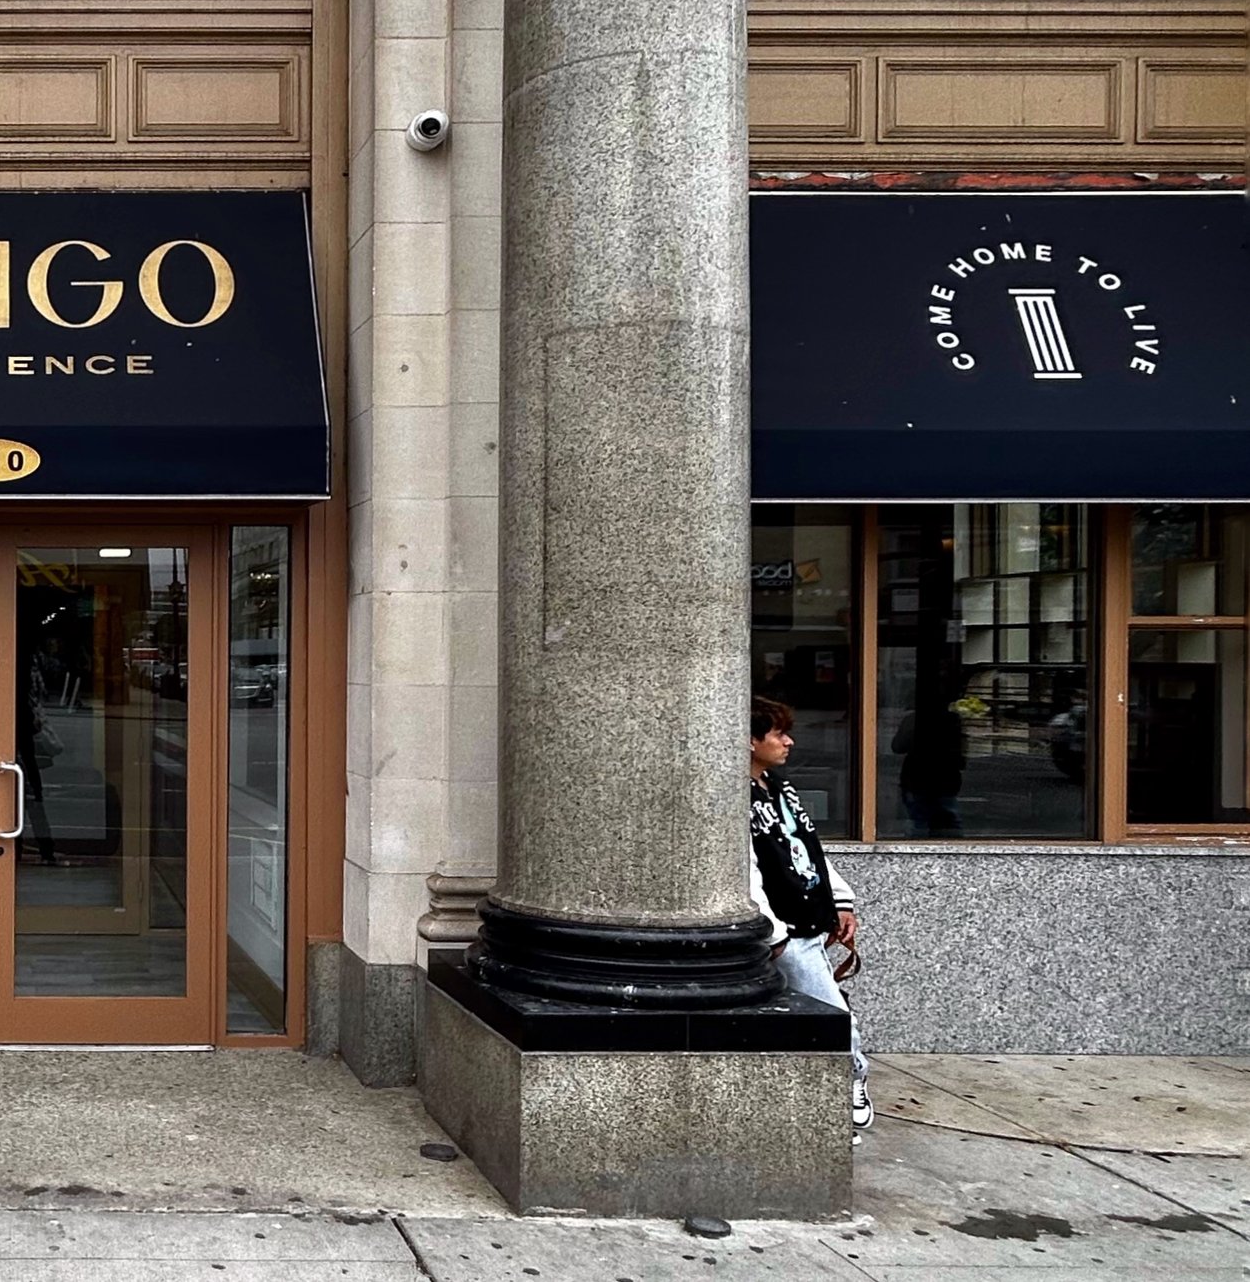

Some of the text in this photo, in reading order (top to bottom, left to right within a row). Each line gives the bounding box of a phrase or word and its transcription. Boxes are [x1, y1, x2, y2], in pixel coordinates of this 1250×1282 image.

[929, 242, 1160, 374] COME HOME TO LIVE
